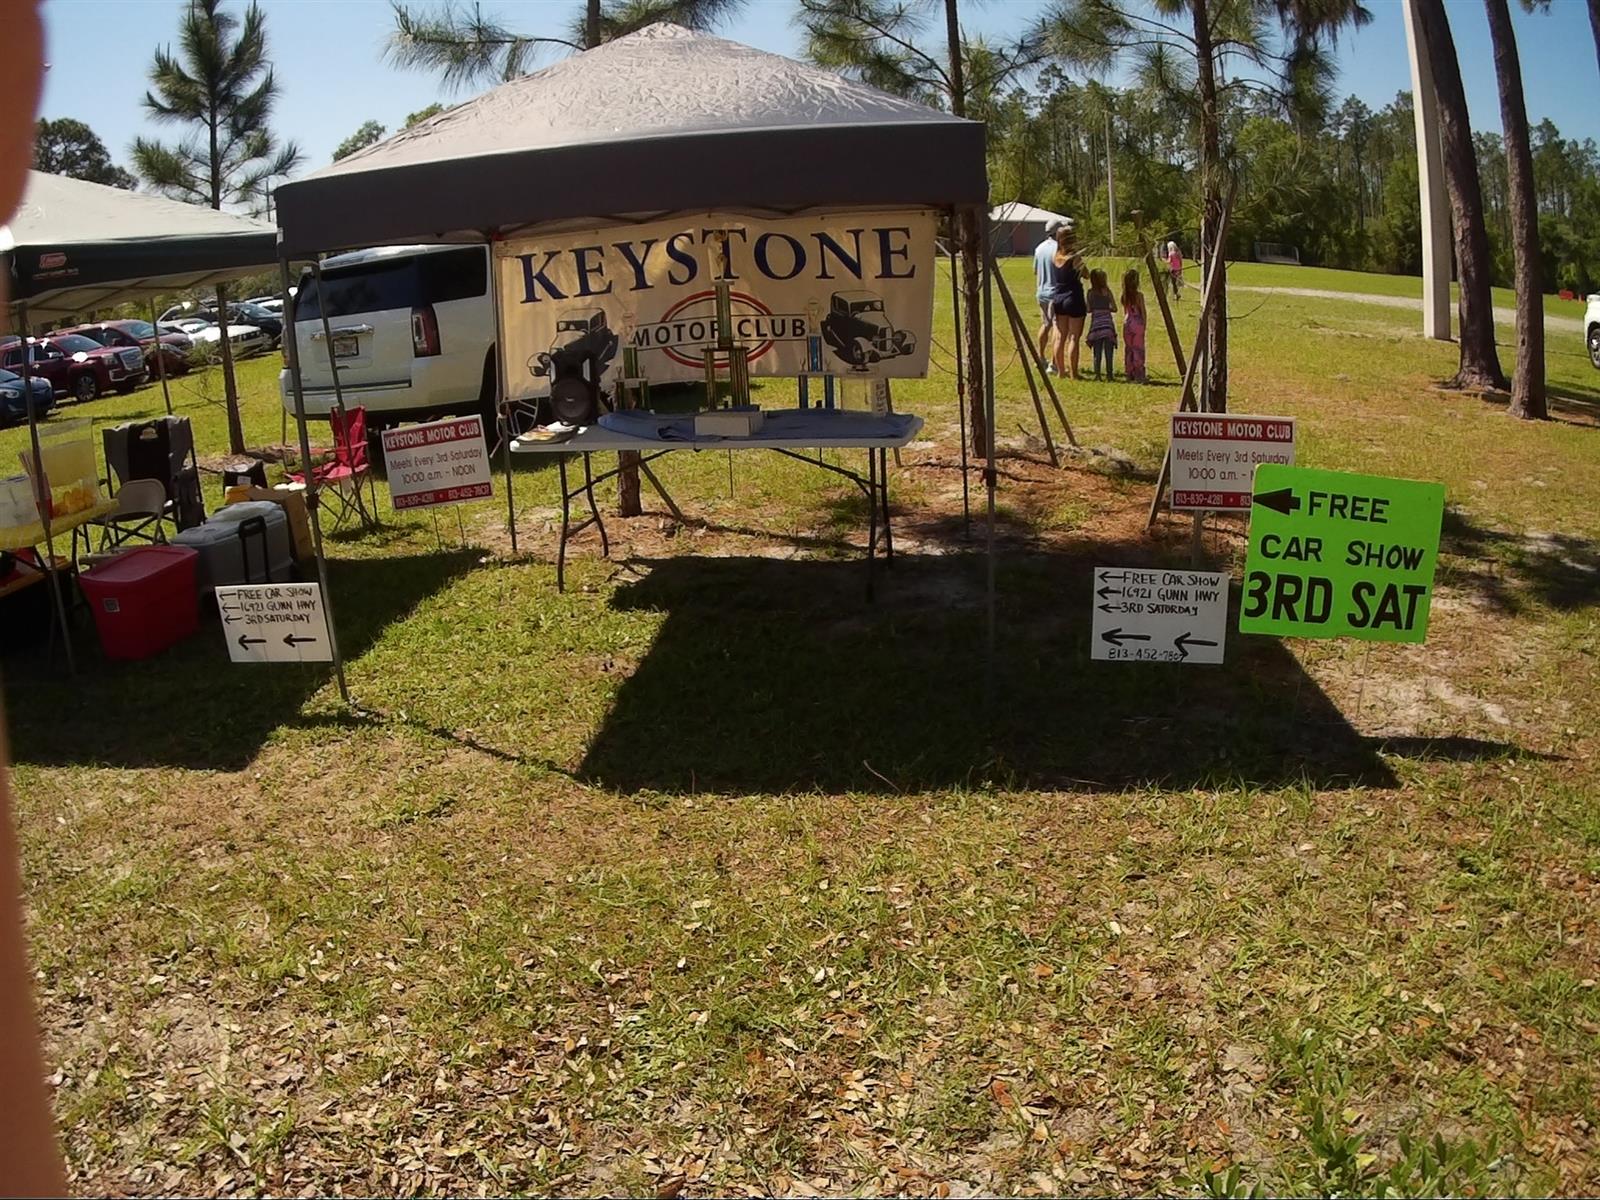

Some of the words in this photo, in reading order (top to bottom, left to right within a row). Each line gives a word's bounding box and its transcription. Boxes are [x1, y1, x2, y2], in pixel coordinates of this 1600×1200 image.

[514, 226, 917, 305] KEYSTONE
[737, 318, 806, 338] CLUB
[386, 432, 425, 449] KEYSTONE
[427, 427, 456, 442] MOTOR
[459, 422, 479, 436] CLUB
[1174, 421, 1224, 436] KEYSTONE
[1227, 423, 1263, 438] MOTOR
[1266, 425, 1291, 439] CLUB
[390, 460, 413, 471] Meets
[414, 456, 434, 468] Every
[436, 452, 448, 464] 3rd
[450, 448, 483, 461] Saturday
[1176, 449, 1204, 460] Meets
[1207, 450, 1231, 464] Every
[1234, 451, 1248, 463] 3rd
[1251, 452, 1290, 465] Saturday
[452, 464, 476, 477] NOON
[1219, 470, 1239, 480] a.m.
[1175, 492, 1224, 506] 813-839-4281
[1308, 491, 1390, 524] FREE
[1260, 534, 1323, 562] CAR
[1345, 540, 1425, 571] SHOW
[1123, 571, 1158, 585] FREE
[1162, 572, 1185, 586] CAR
[1187, 575, 1220, 587] SHOW
[237, 589, 263, 600] FREE
[265, 588, 282, 600] CAR
[286, 587, 313, 598] SHOW
[1122, 587, 1152, 599] 16921
[1157, 588, 1189, 601] GUNN
[1195, 590, 1220, 602] HWY
[1244, 571, 1333, 624] 3RD
[1347, 581, 1427, 631] SAT
[240, 602, 264, 613] 16921
[266, 601, 293, 612] GUNN
[297, 600, 316, 611] HWY
[1120, 602, 1144, 614] 3RD
